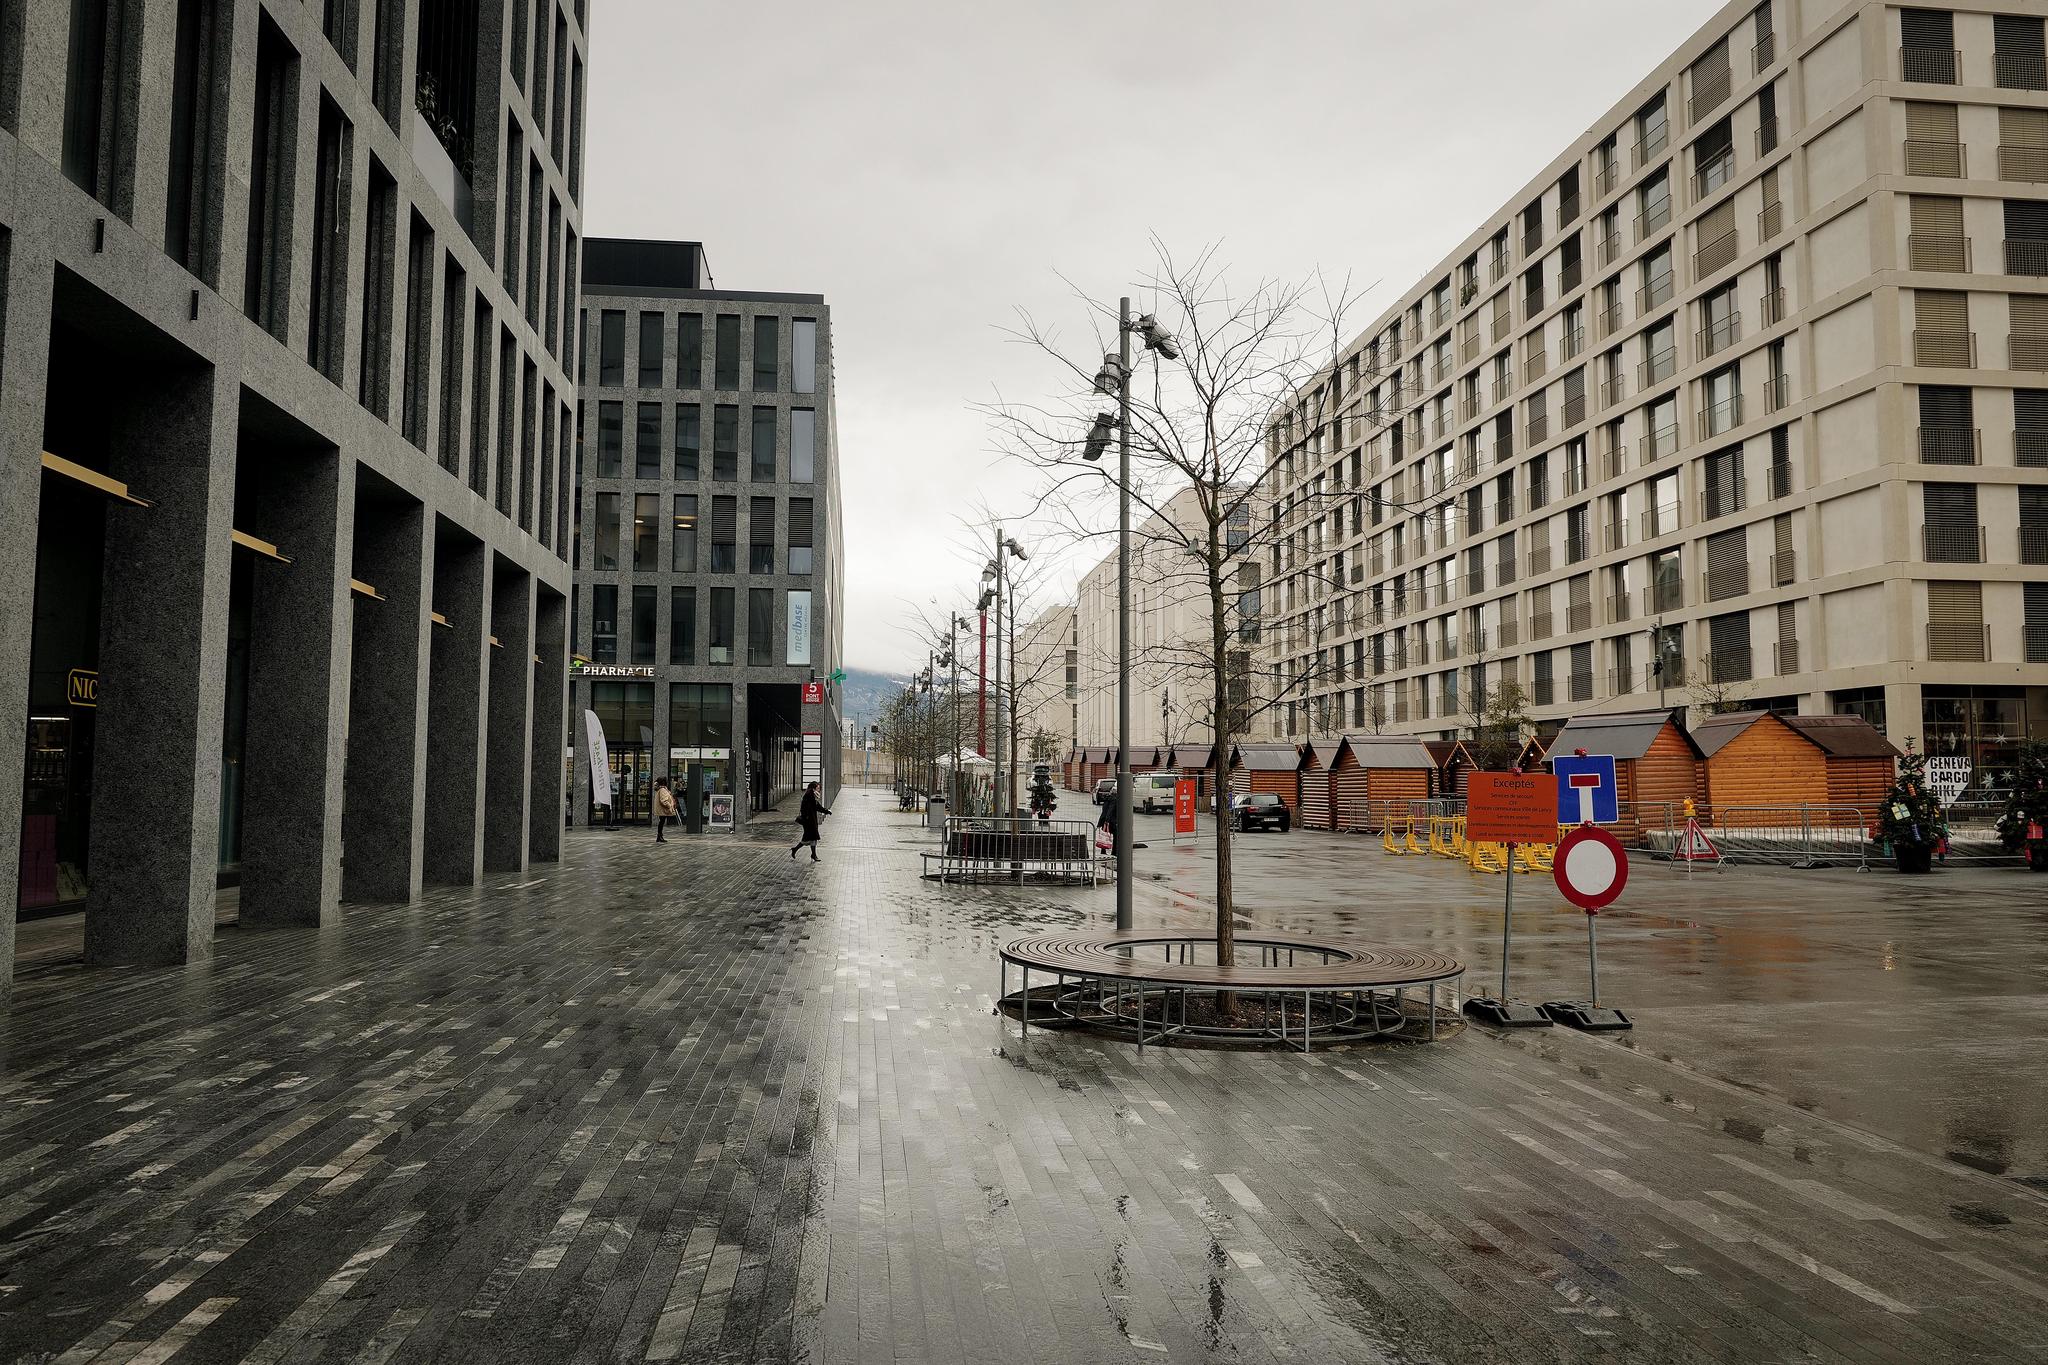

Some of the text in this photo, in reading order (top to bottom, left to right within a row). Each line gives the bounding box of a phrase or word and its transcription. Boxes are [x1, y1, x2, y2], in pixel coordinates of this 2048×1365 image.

[809, 682, 818, 693] 5
[1930, 757, 1972, 769] GENEVA
[1930, 771, 1969, 783] CARGO
[1493, 778, 1535, 790] Exceptés
[1931, 785, 1956, 797] BIKE
